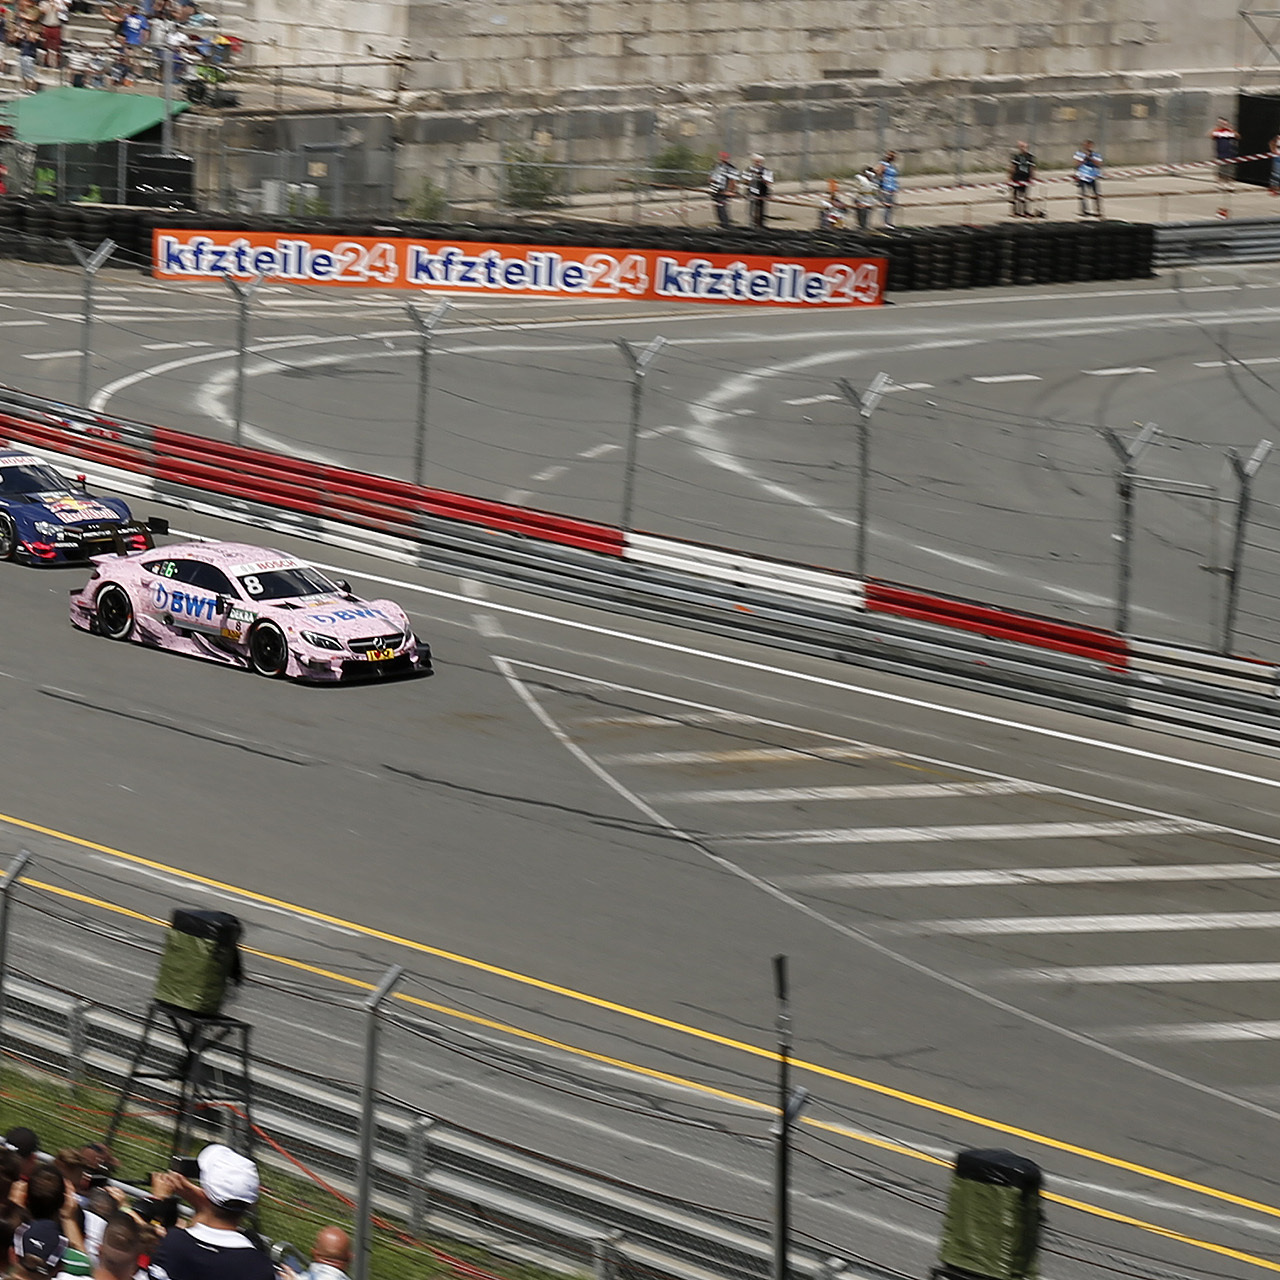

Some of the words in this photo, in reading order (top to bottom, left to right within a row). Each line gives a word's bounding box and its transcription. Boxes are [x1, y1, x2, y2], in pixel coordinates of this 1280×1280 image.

[157, 234, 399, 284] kfzteile24
[407, 245, 648, 295] kfzteile24
[653, 256, 881, 305] kfzteile24
[255, 559, 297, 571] BOSCH
[243, 576, 264, 595] 8
[170, 590, 218, 621] BWT
[229, 609, 255, 623] DEKRA
[338, 608, 388, 622] BWT
